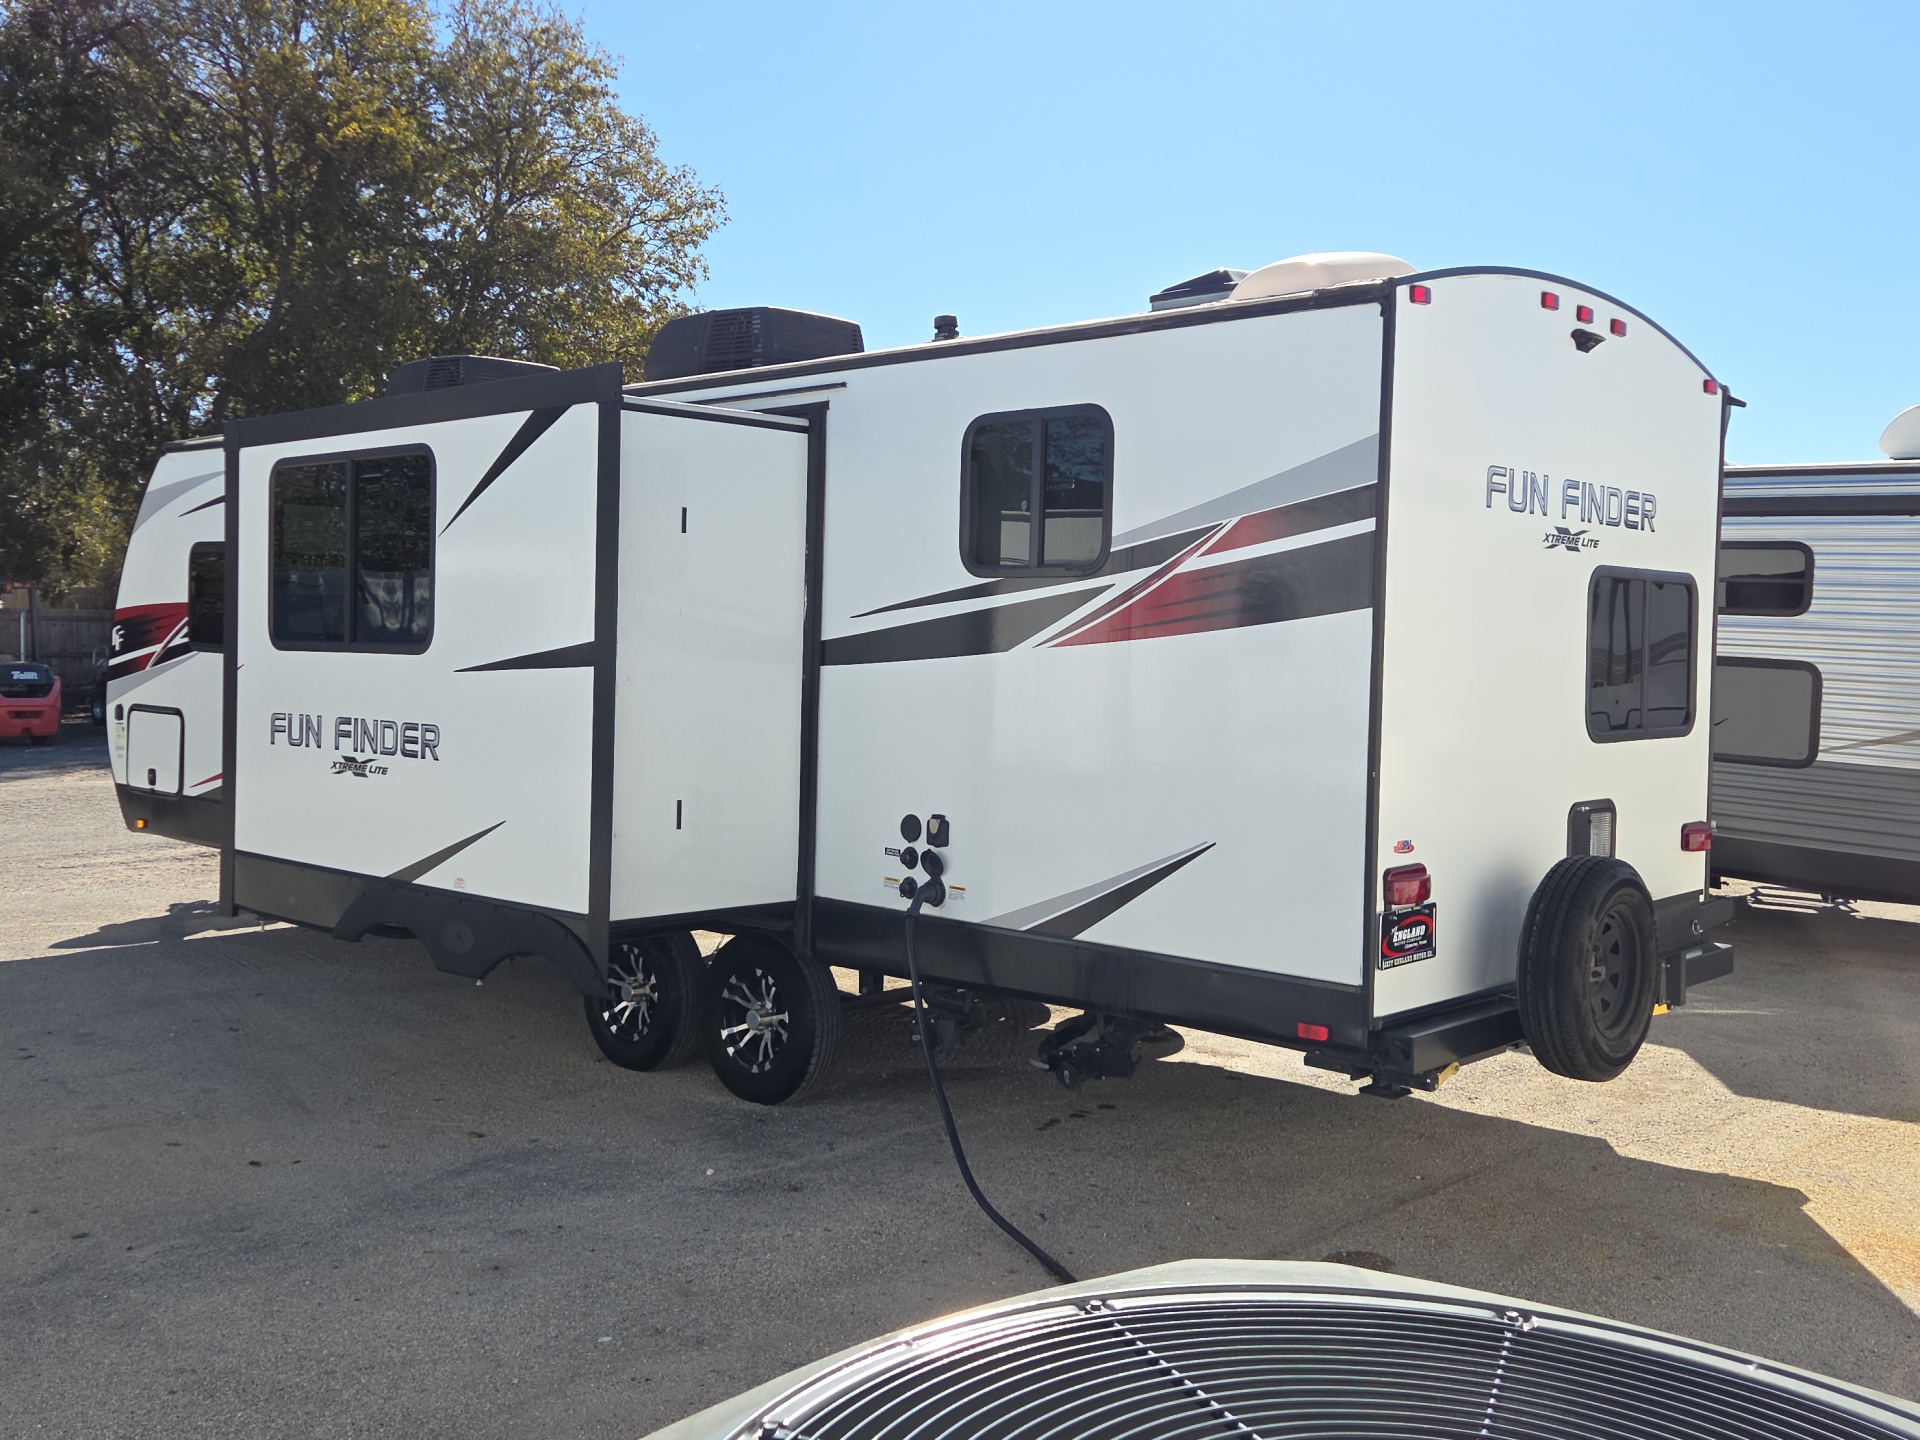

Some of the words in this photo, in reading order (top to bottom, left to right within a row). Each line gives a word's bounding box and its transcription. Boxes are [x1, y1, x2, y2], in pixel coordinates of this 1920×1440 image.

[1485, 464, 1549, 517] FUN
[1561, 478, 1657, 533] FINDER
[1543, 532, 1580, 547] XTREME
[1581, 537, 1600, 549] LITE
[270, 712, 323, 749] FUN
[334, 715, 441, 762] FINDER
[330, 760, 368, 774] XTREME
[368, 765, 389, 776] LITE
[1393, 925, 1426, 943] ENGLAND
